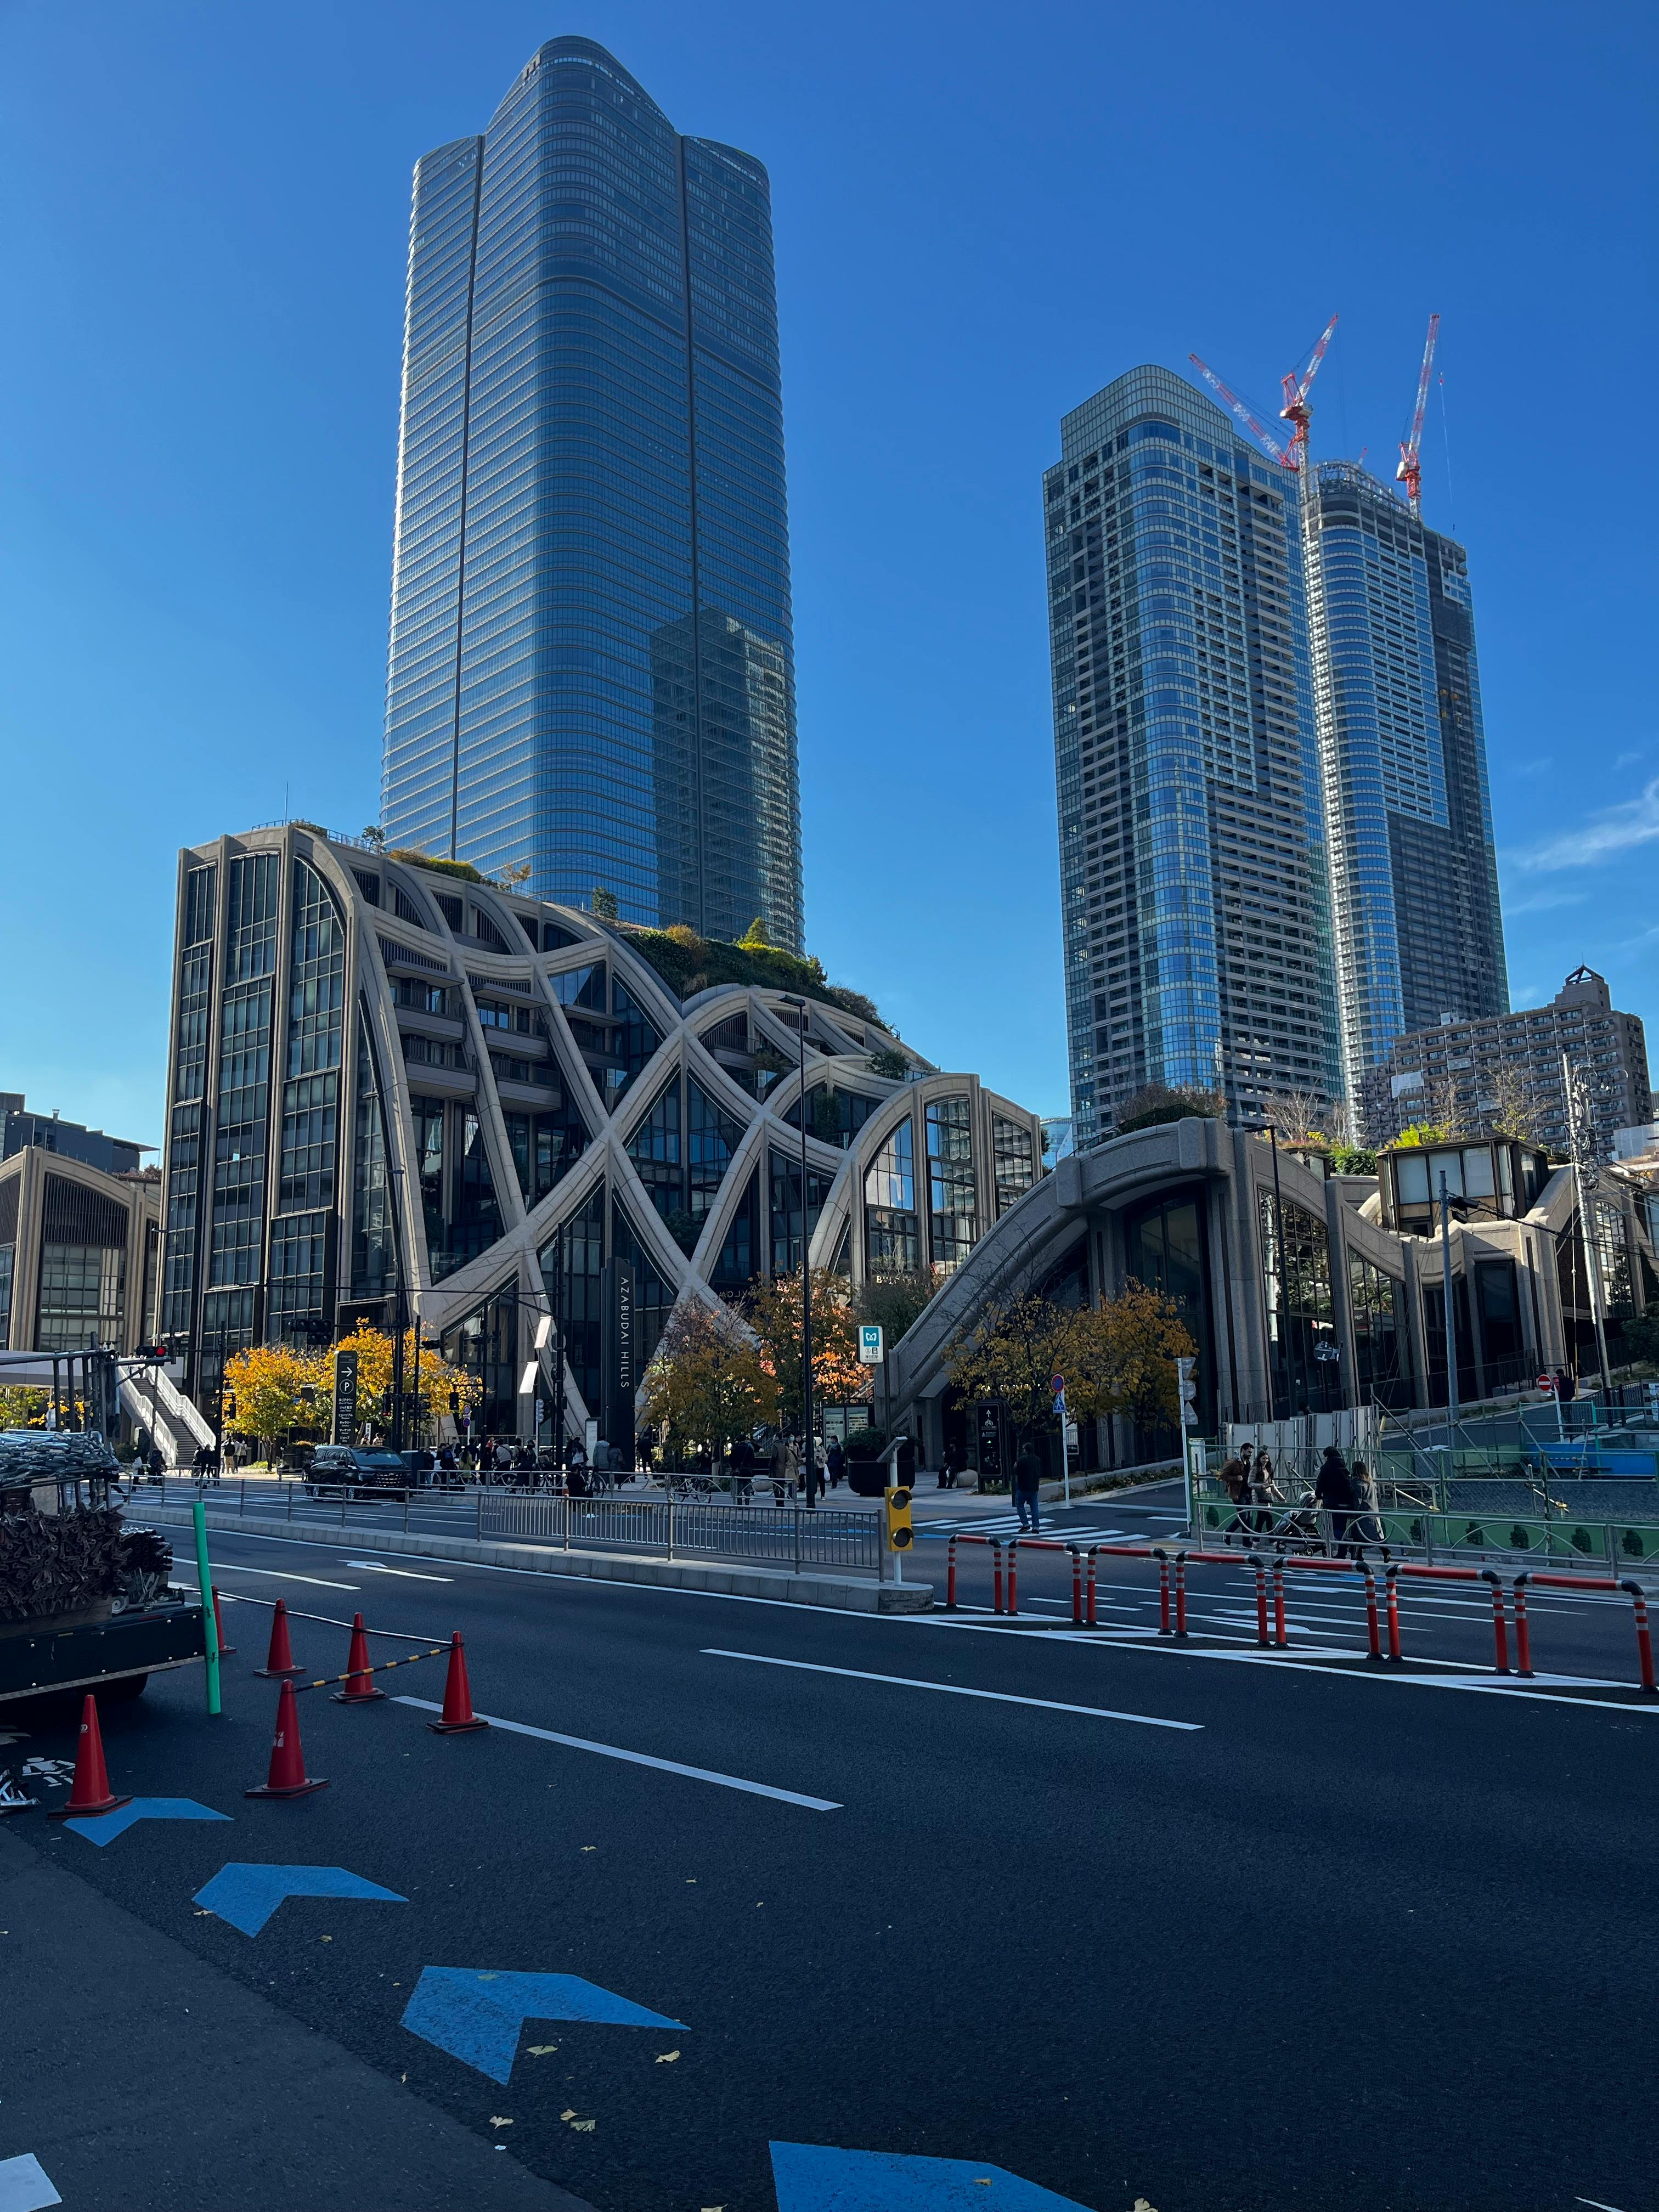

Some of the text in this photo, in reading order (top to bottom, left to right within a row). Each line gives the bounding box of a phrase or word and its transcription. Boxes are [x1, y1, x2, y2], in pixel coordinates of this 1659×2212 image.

[620, 1277, 629, 1387] AZABUDAI HILLS
[345, 1381, 350, 1391] P
